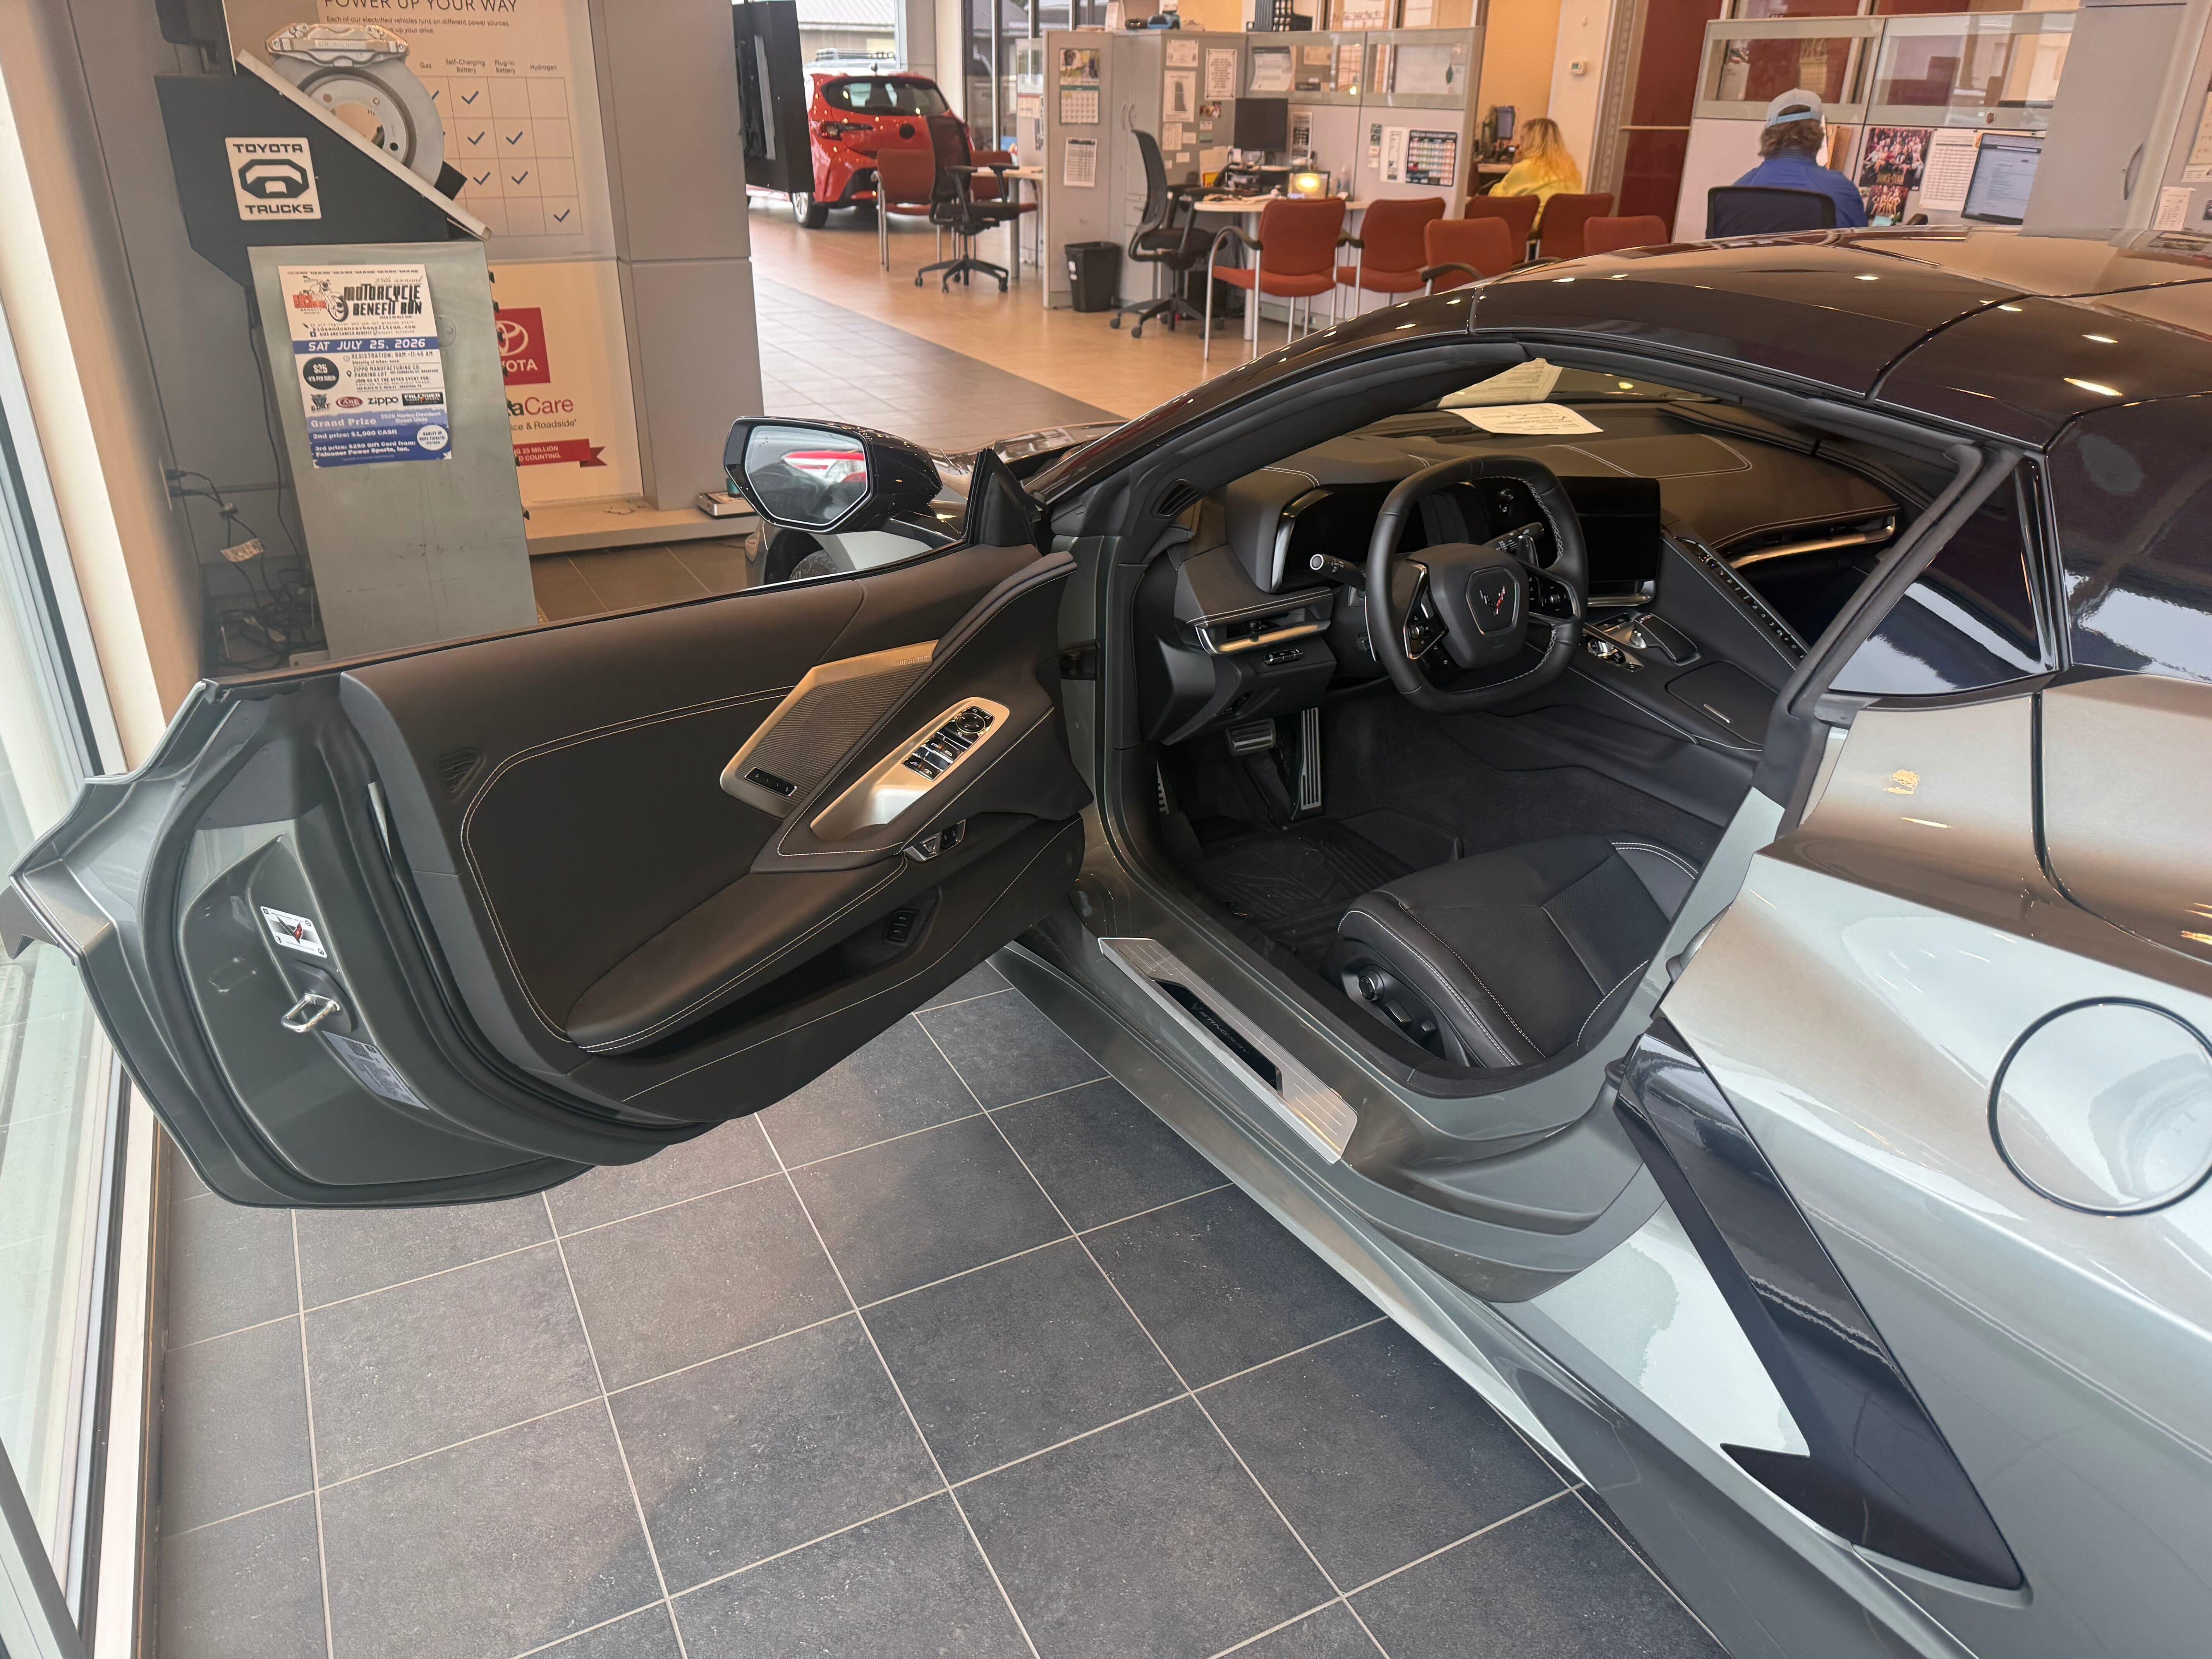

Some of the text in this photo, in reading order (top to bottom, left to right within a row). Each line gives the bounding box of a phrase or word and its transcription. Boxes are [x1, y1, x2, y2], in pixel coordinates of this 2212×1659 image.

[481, 0, 515, 12] WAY
[233, 143, 303, 153] TOYOTA
[245, 204, 314, 214] TRUCKS
[344, 283, 421, 301] MOTORCYCLE
[353, 300, 422, 316] BENEFIT RUN
[308, 338, 426, 351] SAT JULY 25, 2026
[313, 364, 328, 374] $25
[367, 396, 398, 406] zippo
[311, 418, 344, 428] Grand
[347, 417, 377, 427] Prize
[525, 452, 562, 461] COUNTING.
[1199, 1011, 1251, 1054] STINGRAY
